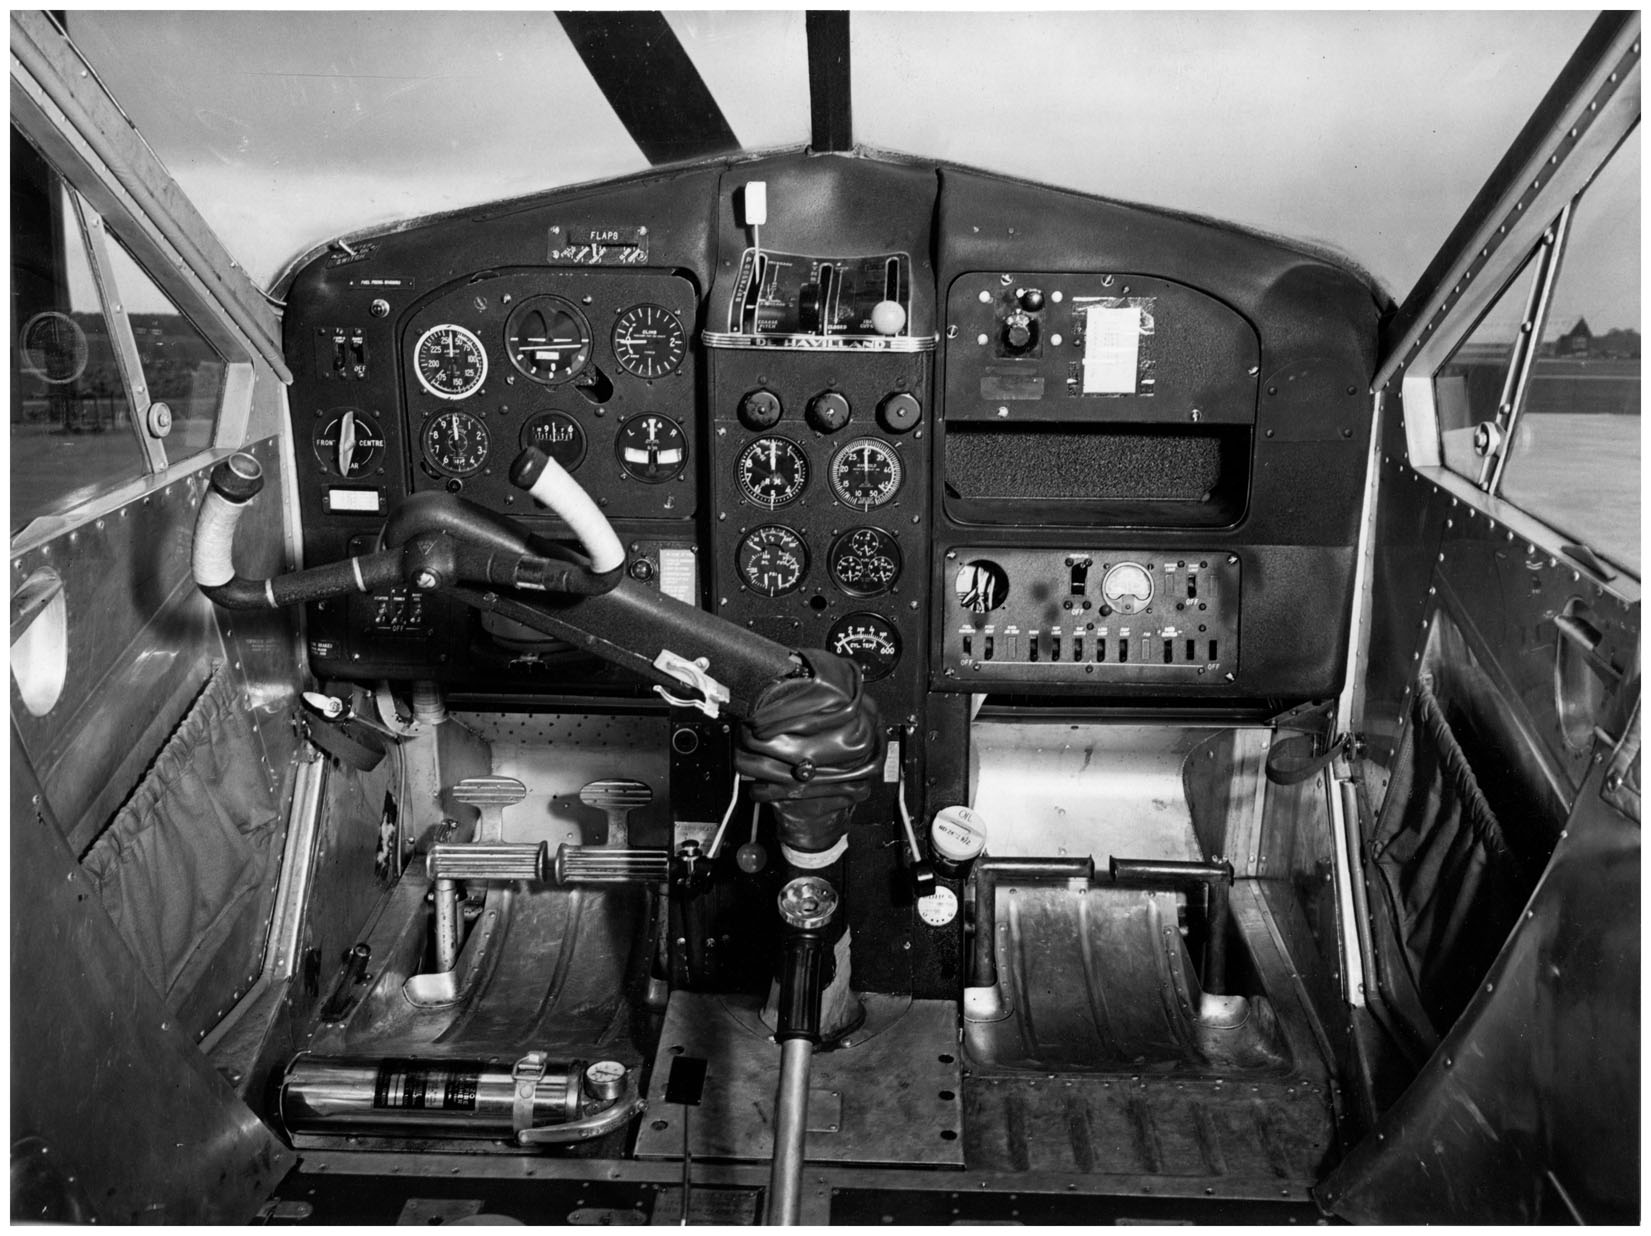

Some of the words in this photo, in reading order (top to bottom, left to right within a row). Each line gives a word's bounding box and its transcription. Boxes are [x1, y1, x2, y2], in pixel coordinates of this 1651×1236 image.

[590, 231, 619, 241] FLAPS
[454, 337, 464, 346] 50
[669, 337, 676, 348] 2
[784, 338, 886, 348] HAVILLAND
[430, 346, 442, 354] 225
[463, 344, 471, 352] 75
[428, 360, 440, 368] 200
[464, 369, 475, 377] 125
[452, 378, 463, 386] 150
[440, 420, 447, 430] 9
[467, 421, 471, 430] 1
[567, 425, 574, 433] 6
[433, 430, 439, 440] 8
[476, 431, 482, 441] 2
[627, 428, 636, 437] L
[669, 428, 678, 437] R
[358, 439, 384, 447] CENTRE
[434, 444, 440, 454] 7
[477, 445, 483, 455] 3
[442, 455, 449, 464] 6
[848, 453, 857, 461] 25
[745, 473, 752, 483] 7
[842, 480, 849, 488] 15
[1185, 598, 1199, 606] OFF
[1071, 608, 1084, 616] OFF
[836, 646, 842, 655] 0
[880, 646, 895, 655] 600
